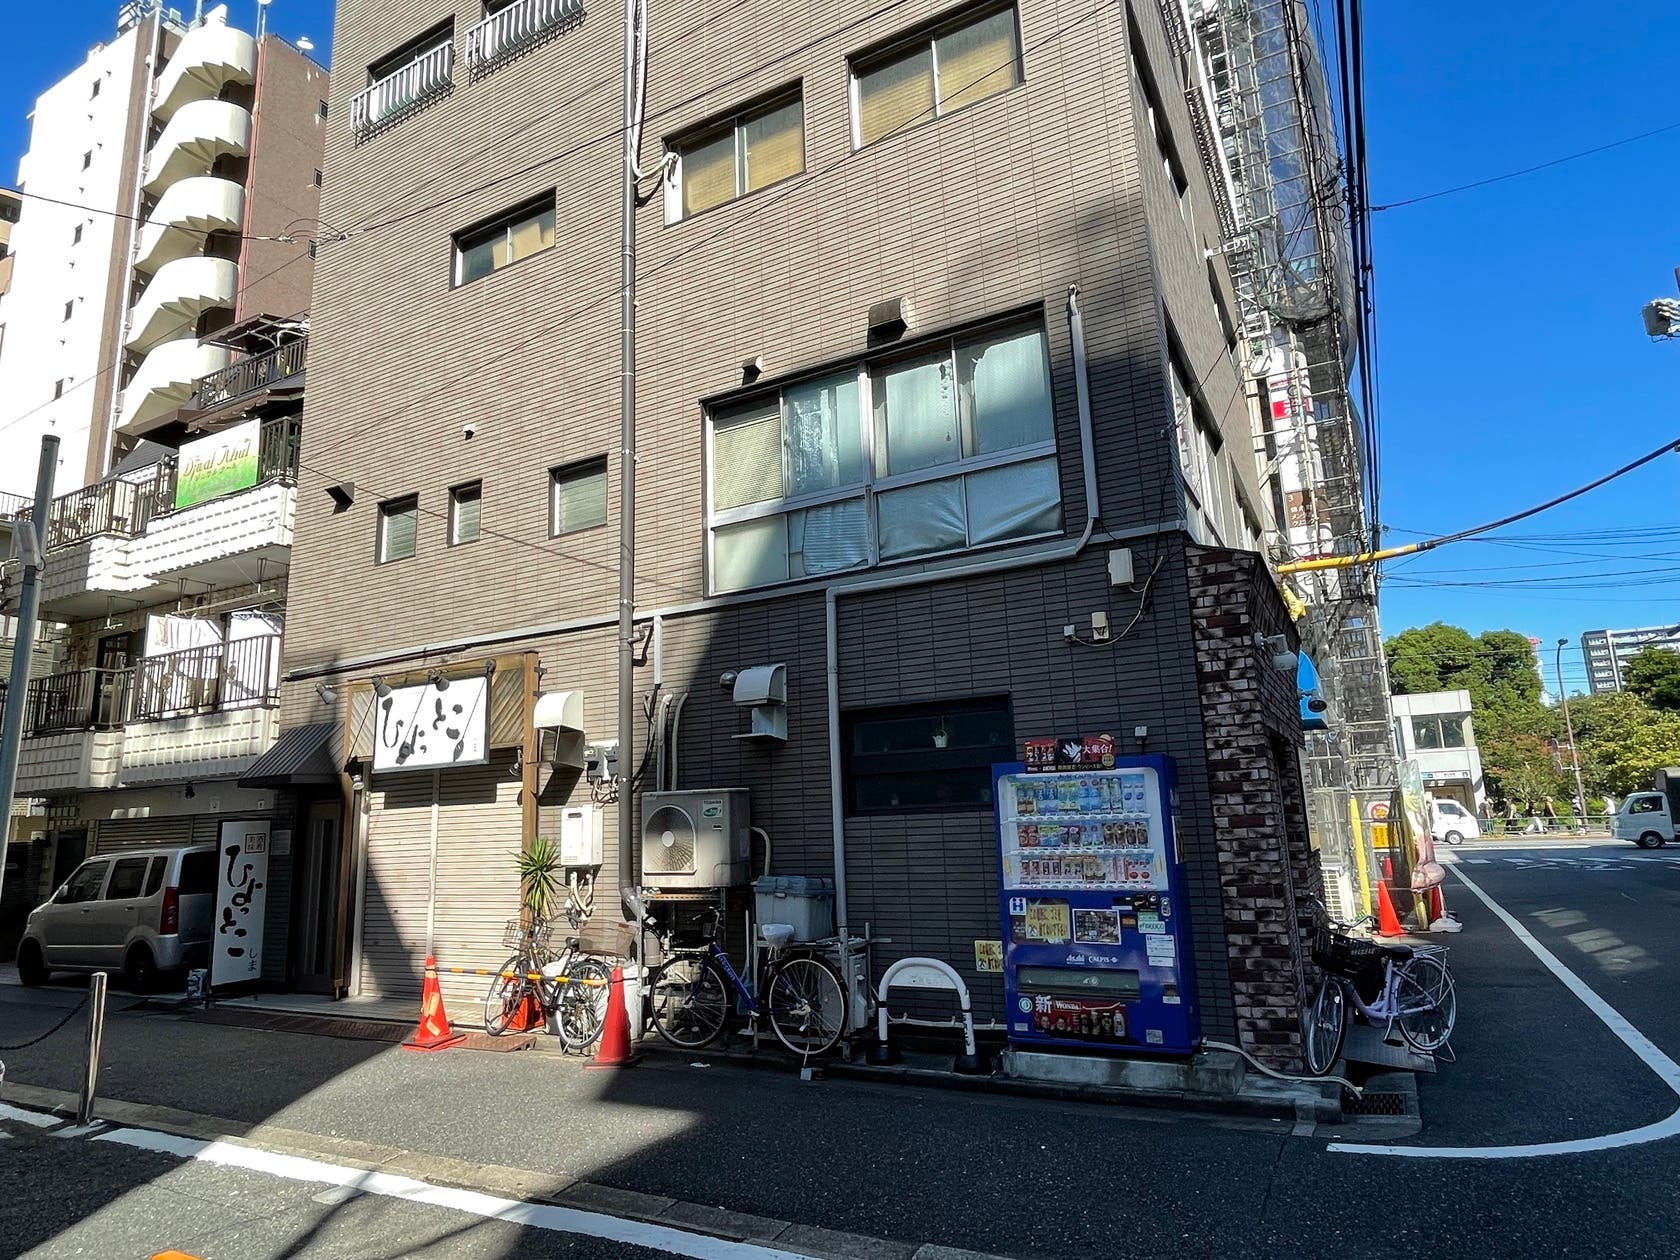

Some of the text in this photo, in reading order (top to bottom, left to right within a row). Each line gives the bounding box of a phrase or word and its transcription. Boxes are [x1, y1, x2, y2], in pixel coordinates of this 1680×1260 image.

[220, 845, 263, 957] ひょっとこ
[1036, 995, 1052, 1013] 新
